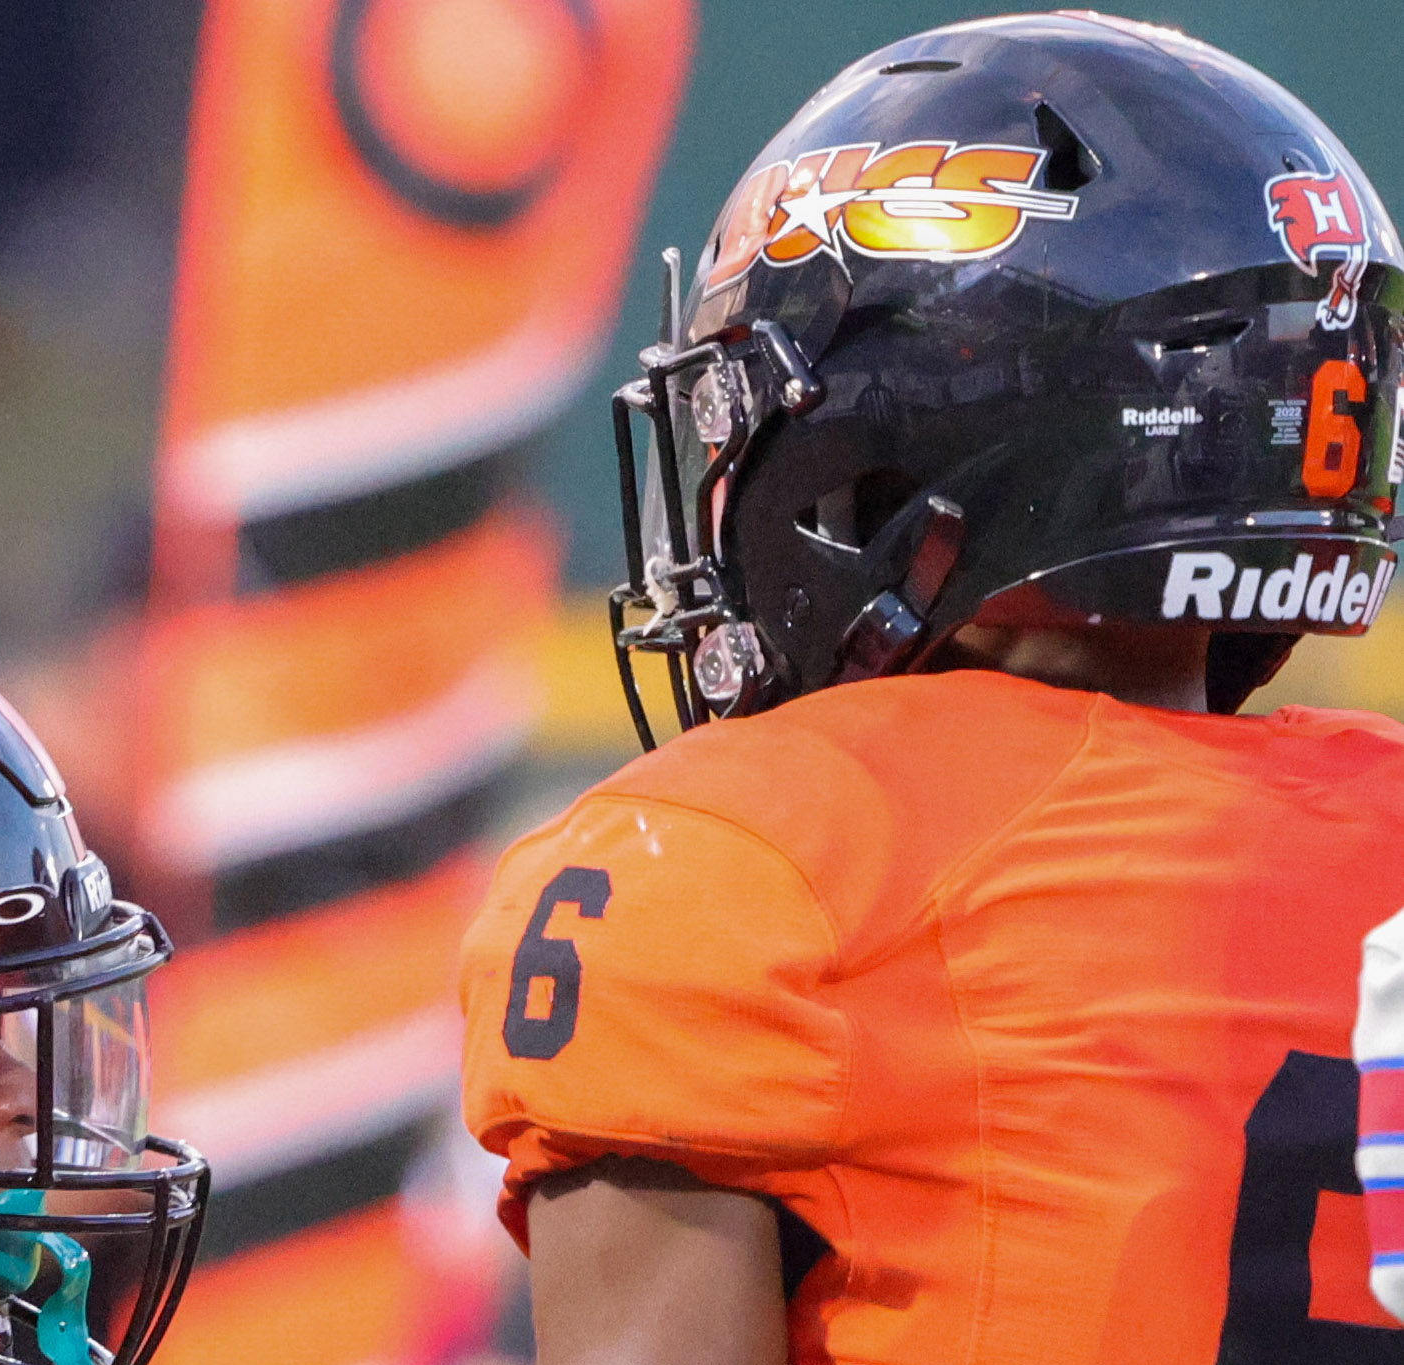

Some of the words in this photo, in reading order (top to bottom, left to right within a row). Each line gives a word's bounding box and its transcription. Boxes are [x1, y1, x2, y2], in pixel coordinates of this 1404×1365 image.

[701, 140, 1050, 303] BUCS
[1302, 188, 1353, 236] H
[1122, 406, 1195, 426] Riddell
[1144, 424, 1180, 437] LARGE
[1274, 406, 1303, 418] 2022
[1301, 360, 1368, 499] 6
[1161, 551, 1397, 626] Riddell
[501, 865, 613, 1061] 6
